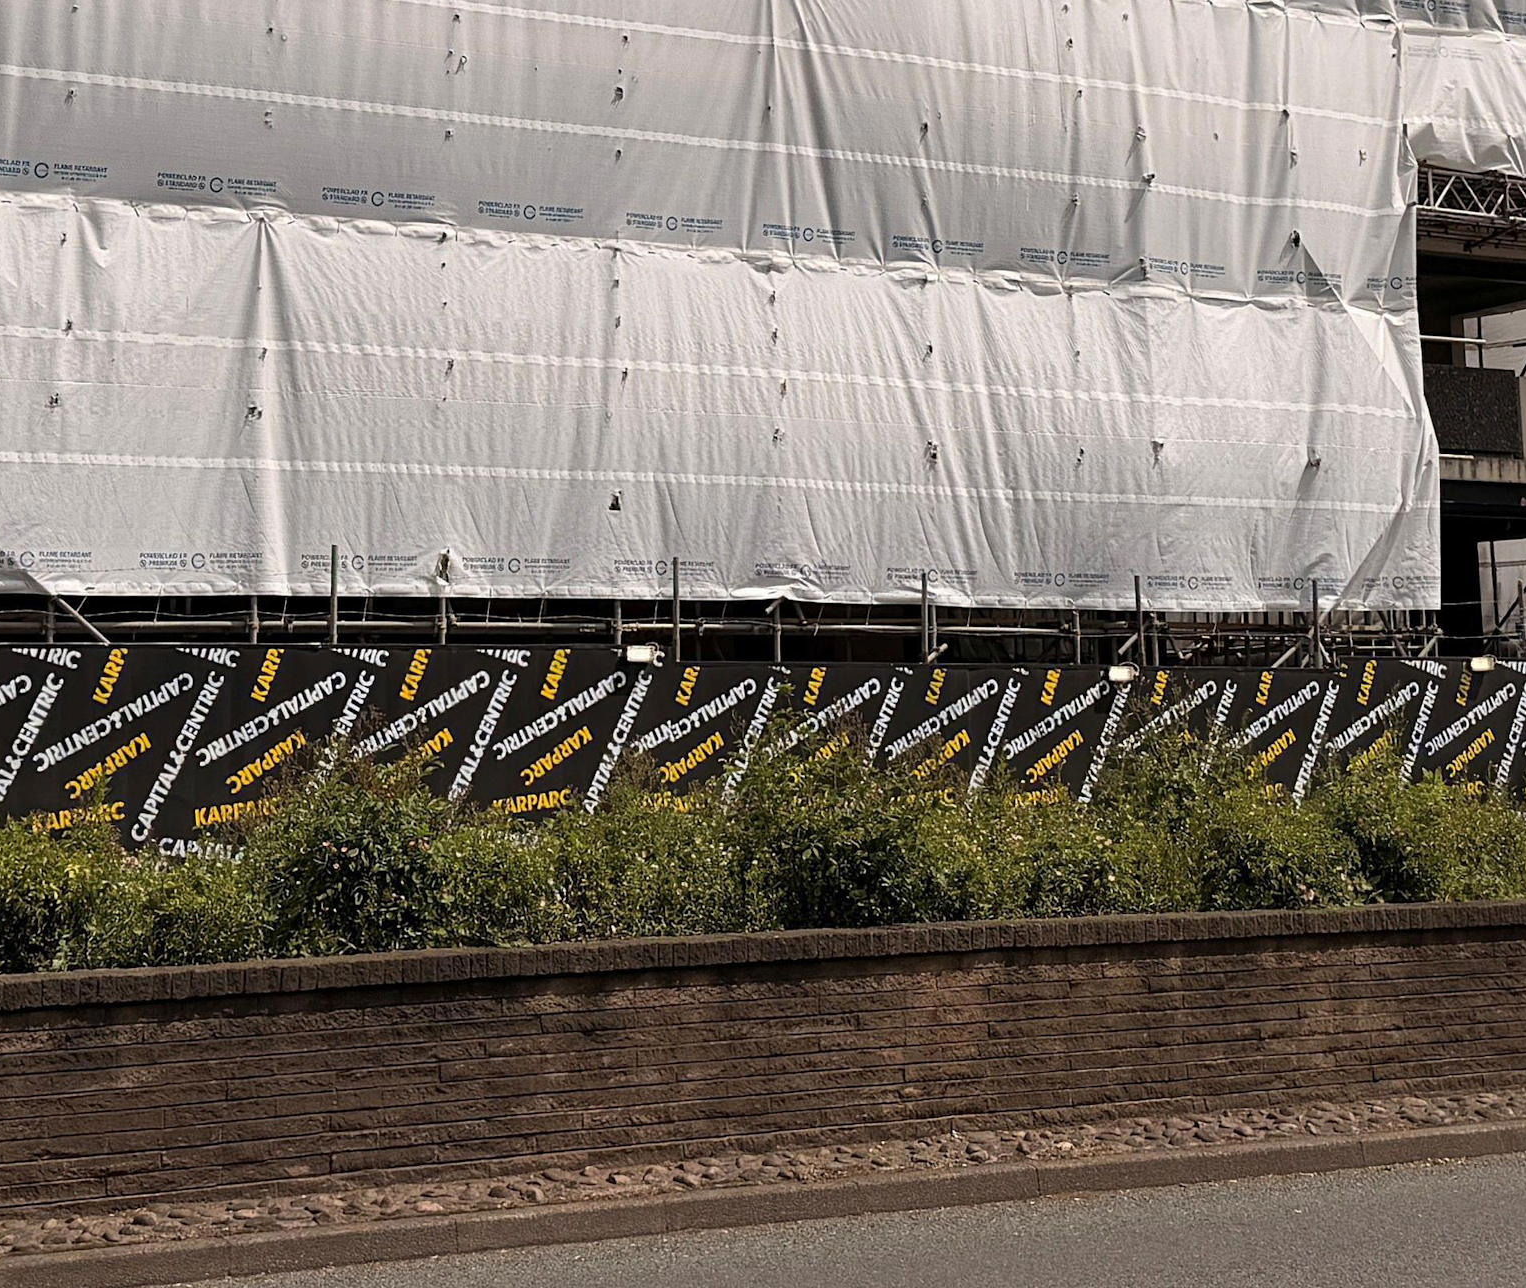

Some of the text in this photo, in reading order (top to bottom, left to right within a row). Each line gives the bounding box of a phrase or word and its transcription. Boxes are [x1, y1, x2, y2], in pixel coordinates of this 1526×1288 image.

[92, 648, 129, 705] KARP
[250, 649, 284, 702] KARP
[399, 649, 431, 701] KARP
[540, 649, 571, 700] KARP
[803, 667, 827, 706] KAR
[925, 668, 947, 706] KAR
[1040, 669, 1061, 706] KAR
[1151, 670, 1170, 706] KAR
[1255, 670, 1274, 706] KAR
[32, 672, 193, 772] CAPITAL&CENTRIC
[195, 671, 347, 767] CAPITAL&CENTRIC
[492, 670, 626, 760] CAPITAL&CENTRIC
[1425, 682, 1516, 756] CAPITAL&CENTRIC
[131, 670, 225, 842] CAPITAL&CENTRIC
[519, 726, 594, 787] KARPARC
[1446, 728, 1496, 778] KARPARC
